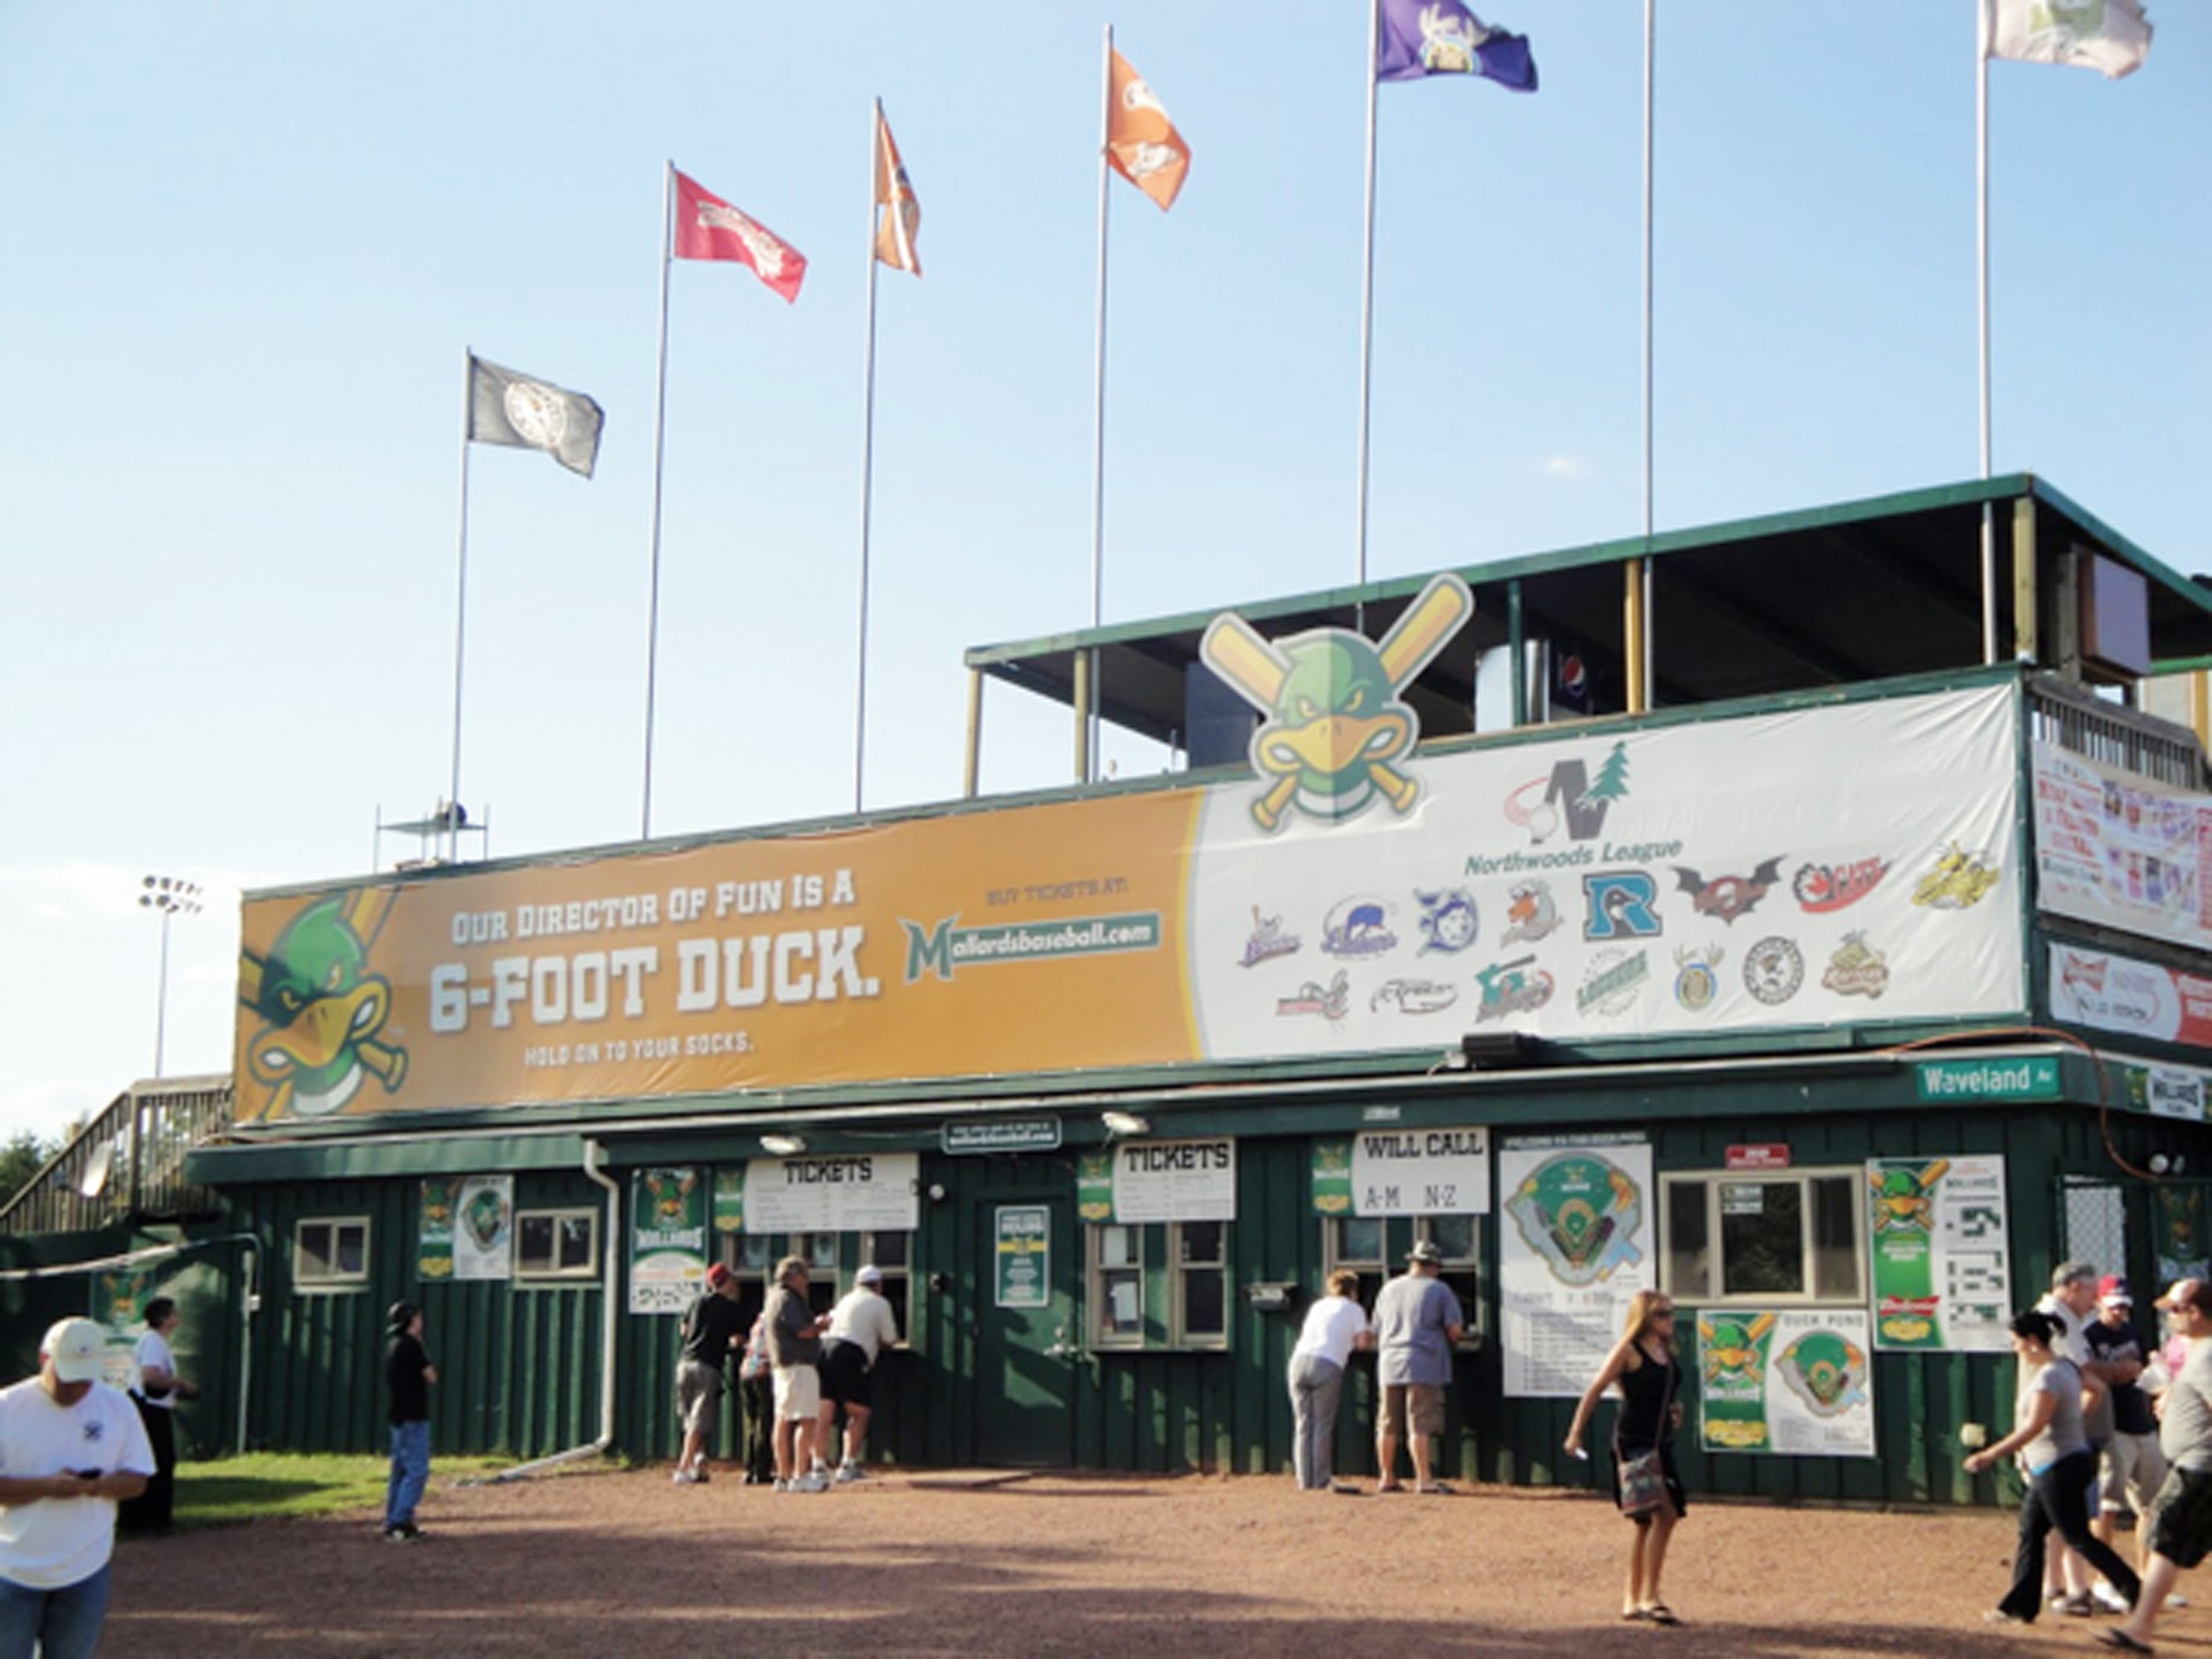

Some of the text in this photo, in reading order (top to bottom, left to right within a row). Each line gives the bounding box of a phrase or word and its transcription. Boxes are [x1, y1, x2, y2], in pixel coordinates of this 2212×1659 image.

[1464, 839, 1685, 876] Northwoods League
[453, 868, 855, 946] OUR DIRECTOR OF FUN IS A
[986, 888, 1019, 906] BUY
[1023, 879, 1099, 902] TICKETS
[430, 925, 881, 1034] 6-FOOT DUCK.
[523, 1031, 754, 1068] HOLD ON TO YOUR SOCKS.
[1923, 1063, 2030, 1095] Waveland
[1124, 1142, 1229, 1172] TICKETS
[1364, 1132, 1483, 1159] WILL CALL
[783, 1157, 873, 1185] TICKETS
[1364, 1184, 1457, 1209] A-M N-Z
